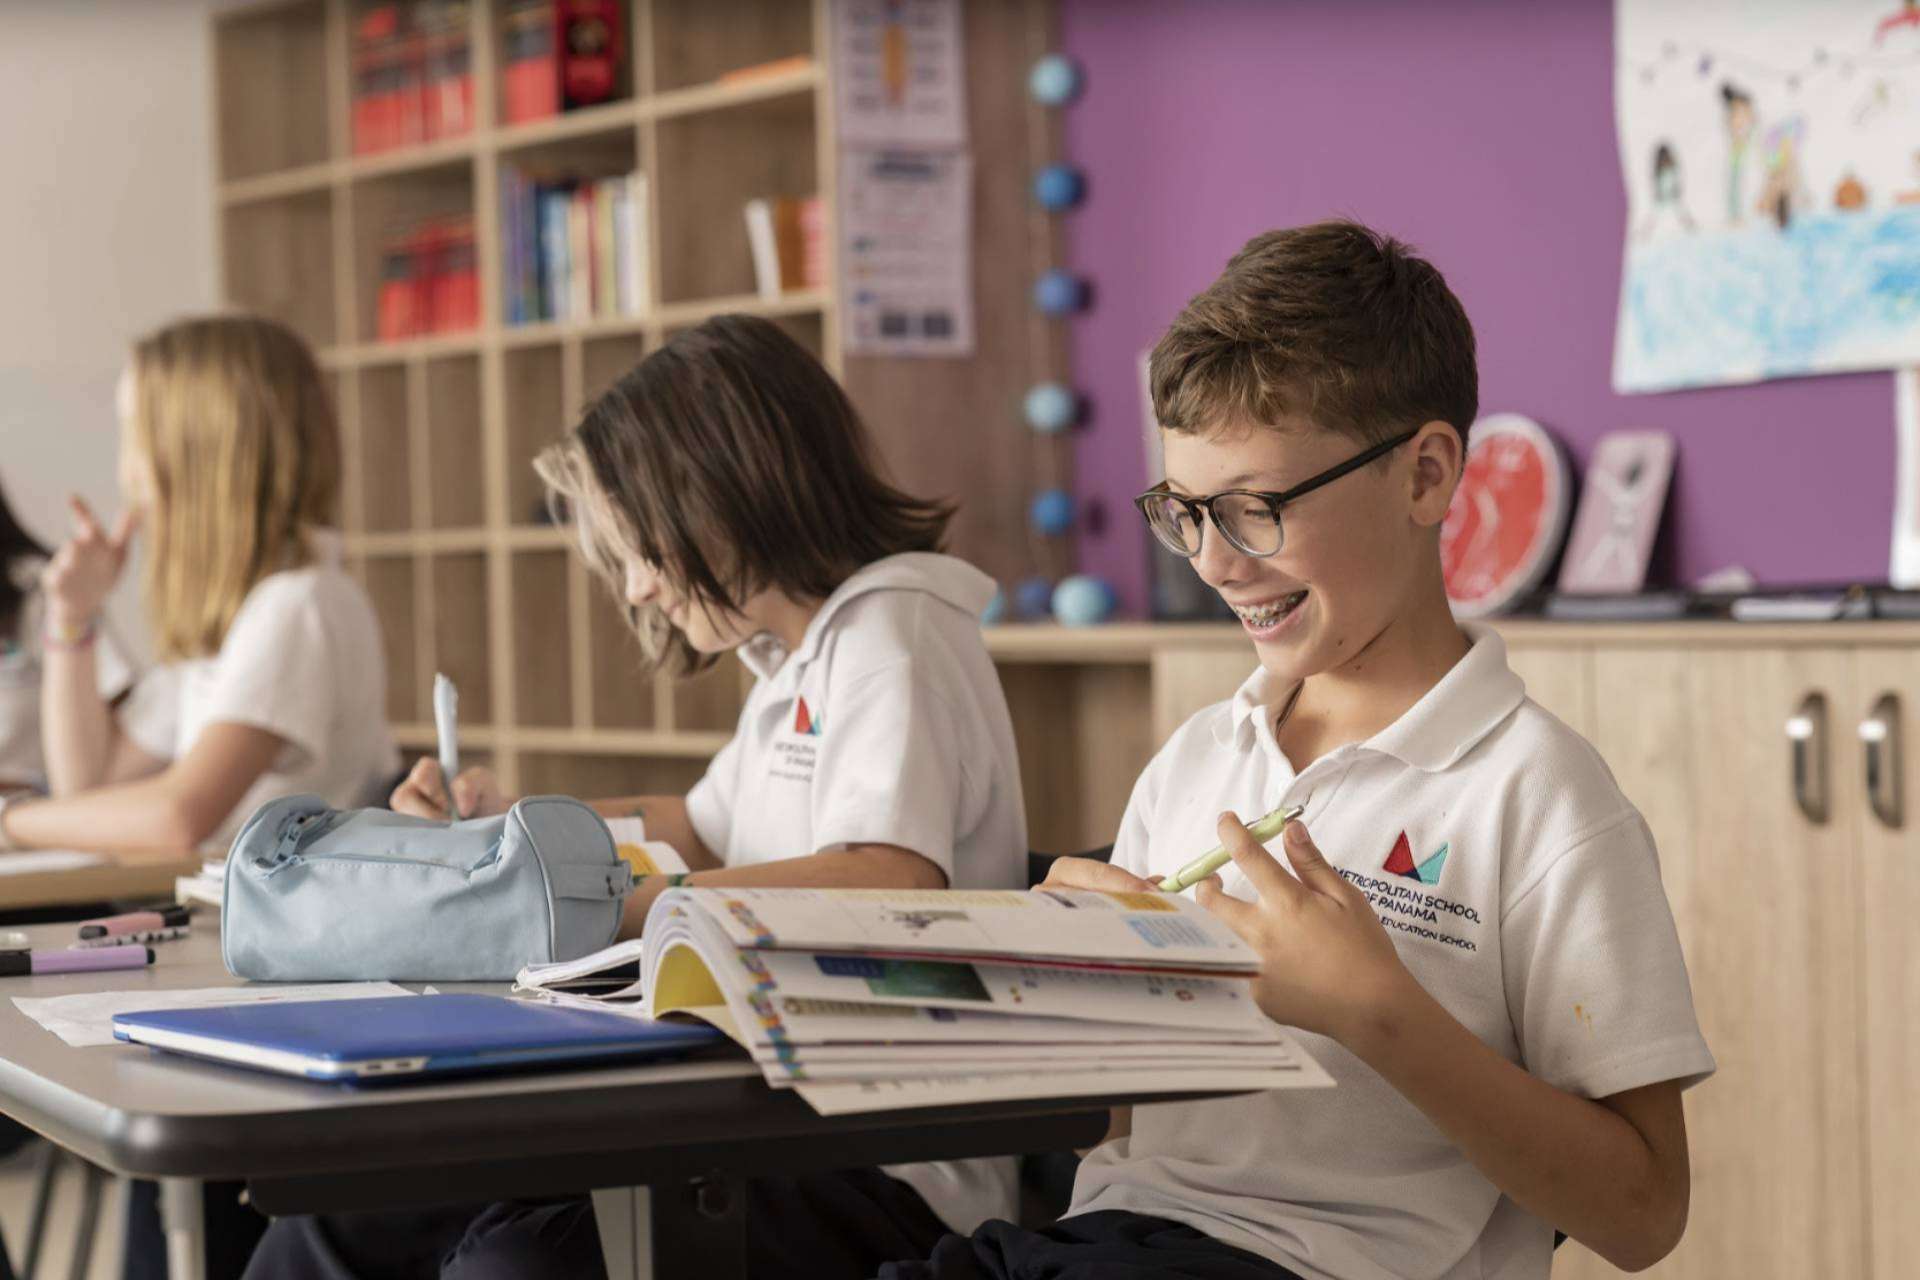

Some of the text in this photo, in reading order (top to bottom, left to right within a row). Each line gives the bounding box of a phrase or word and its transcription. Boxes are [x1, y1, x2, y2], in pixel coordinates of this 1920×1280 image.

[1378, 896, 1438, 924] PANAMA
[1424, 896, 1481, 924] SCHOOL
[1380, 916, 1438, 941] EDUCATION
